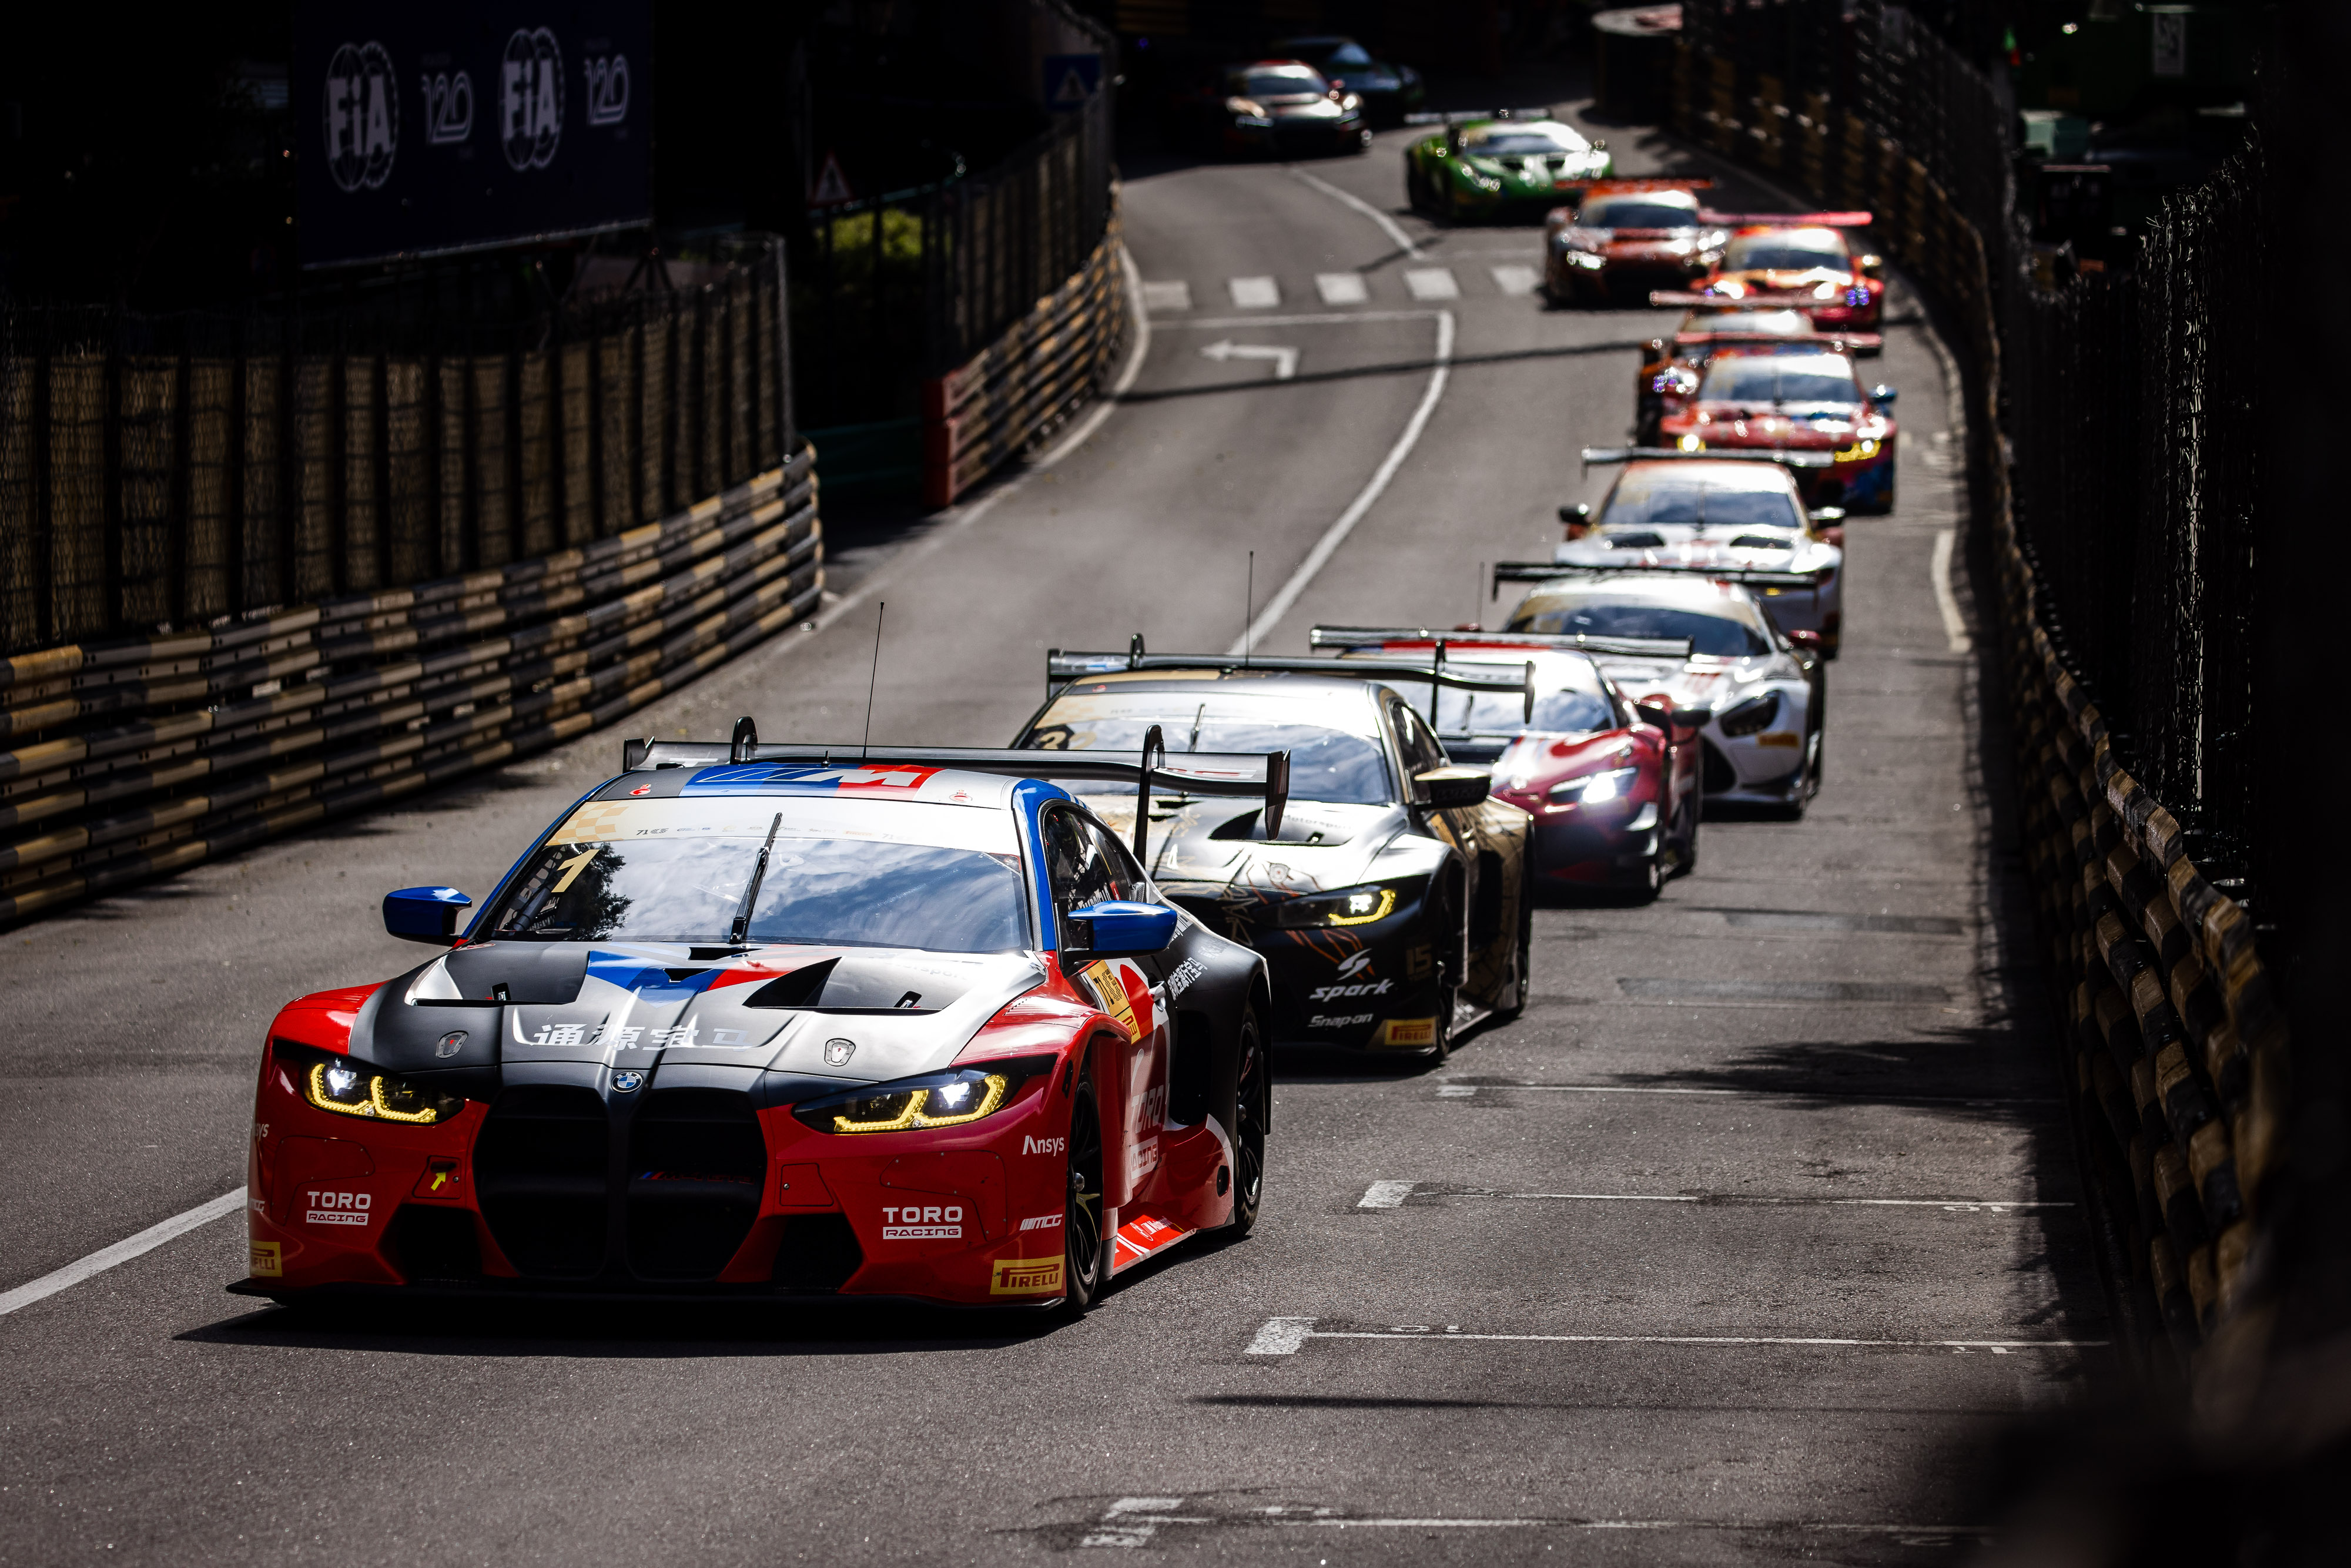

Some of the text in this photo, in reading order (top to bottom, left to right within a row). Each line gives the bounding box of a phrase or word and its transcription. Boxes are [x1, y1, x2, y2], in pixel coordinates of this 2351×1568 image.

[551, 849, 600, 893] 1
[1310, 979, 1395, 1002] spark
[1308, 1014, 1374, 1028] Snap-on
[1022, 1135, 1064, 1157] Ansys
[307, 1191, 371, 1209] TORO
[308, 1213, 367, 1223] RACING
[882, 1206, 963, 1223] TORO
[885, 1228, 959, 1237] RACING
[1000, 1263, 1060, 1288] PIRELLI
